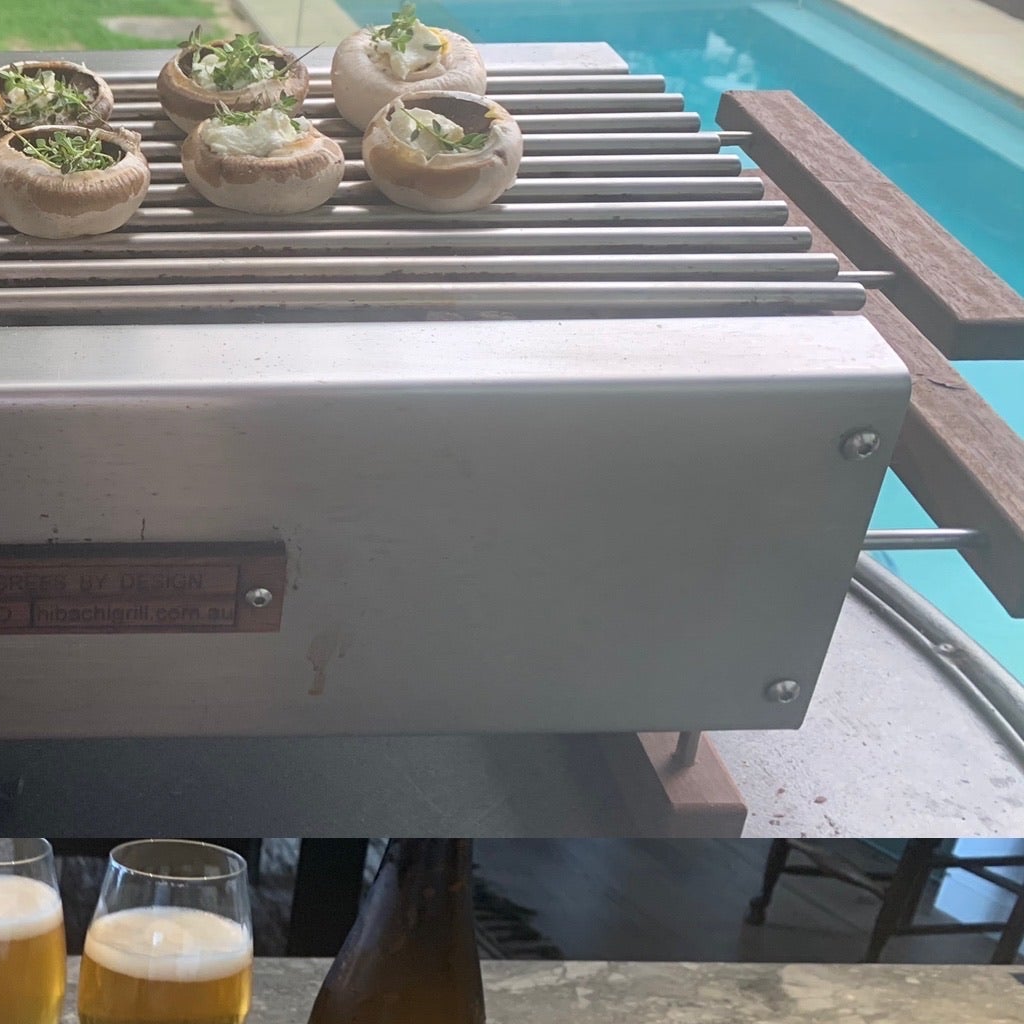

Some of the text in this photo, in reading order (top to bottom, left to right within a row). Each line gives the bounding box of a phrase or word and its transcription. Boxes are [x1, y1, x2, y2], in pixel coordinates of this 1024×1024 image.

[79, 573, 108, 591] BY
[120, 572, 204, 590] DESIGN
[37, 603, 234, 625] hibachigrill.com.au
